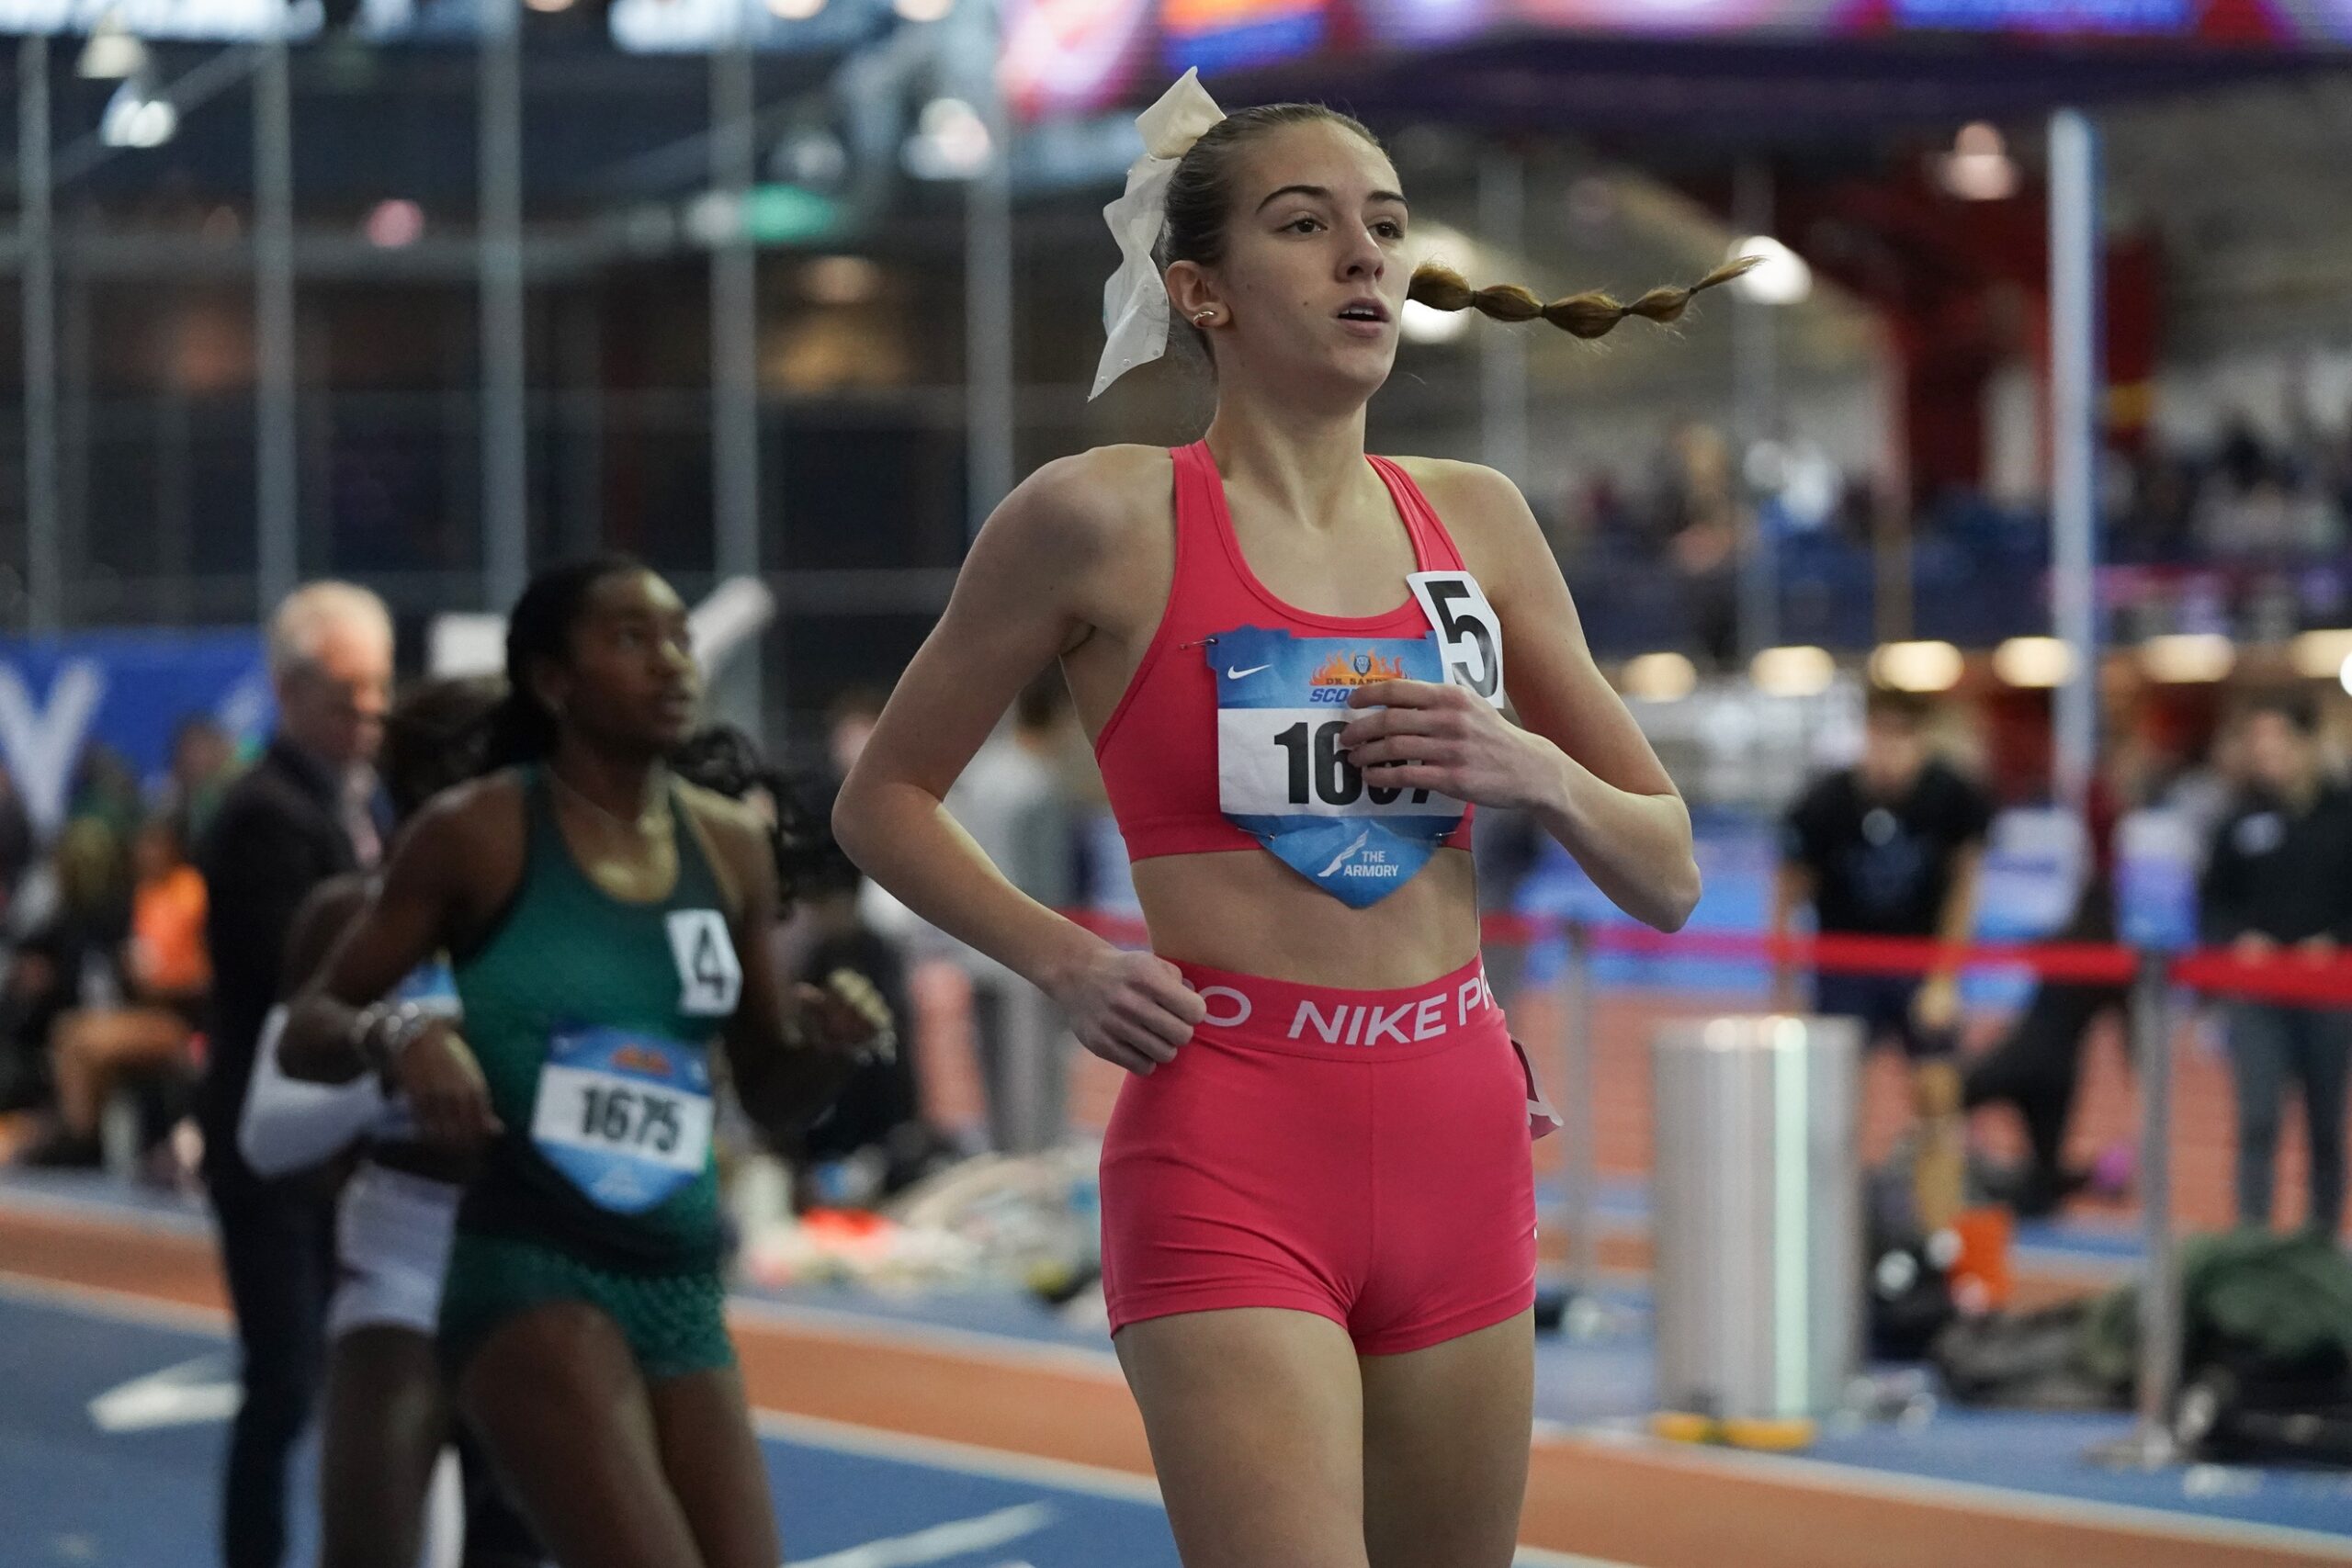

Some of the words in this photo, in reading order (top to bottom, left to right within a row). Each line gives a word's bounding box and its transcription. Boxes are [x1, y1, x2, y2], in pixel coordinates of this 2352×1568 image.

[1425, 581, 1498, 698] 5
[1309, 688, 1358, 703] SCO
[1343, 864, 1398, 877] ARMORY
[1362, 851, 1385, 863] THE
[694, 923, 726, 1001] 4
[1287, 993, 1448, 1046] NIKE
[581, 1085, 681, 1154] 1675
